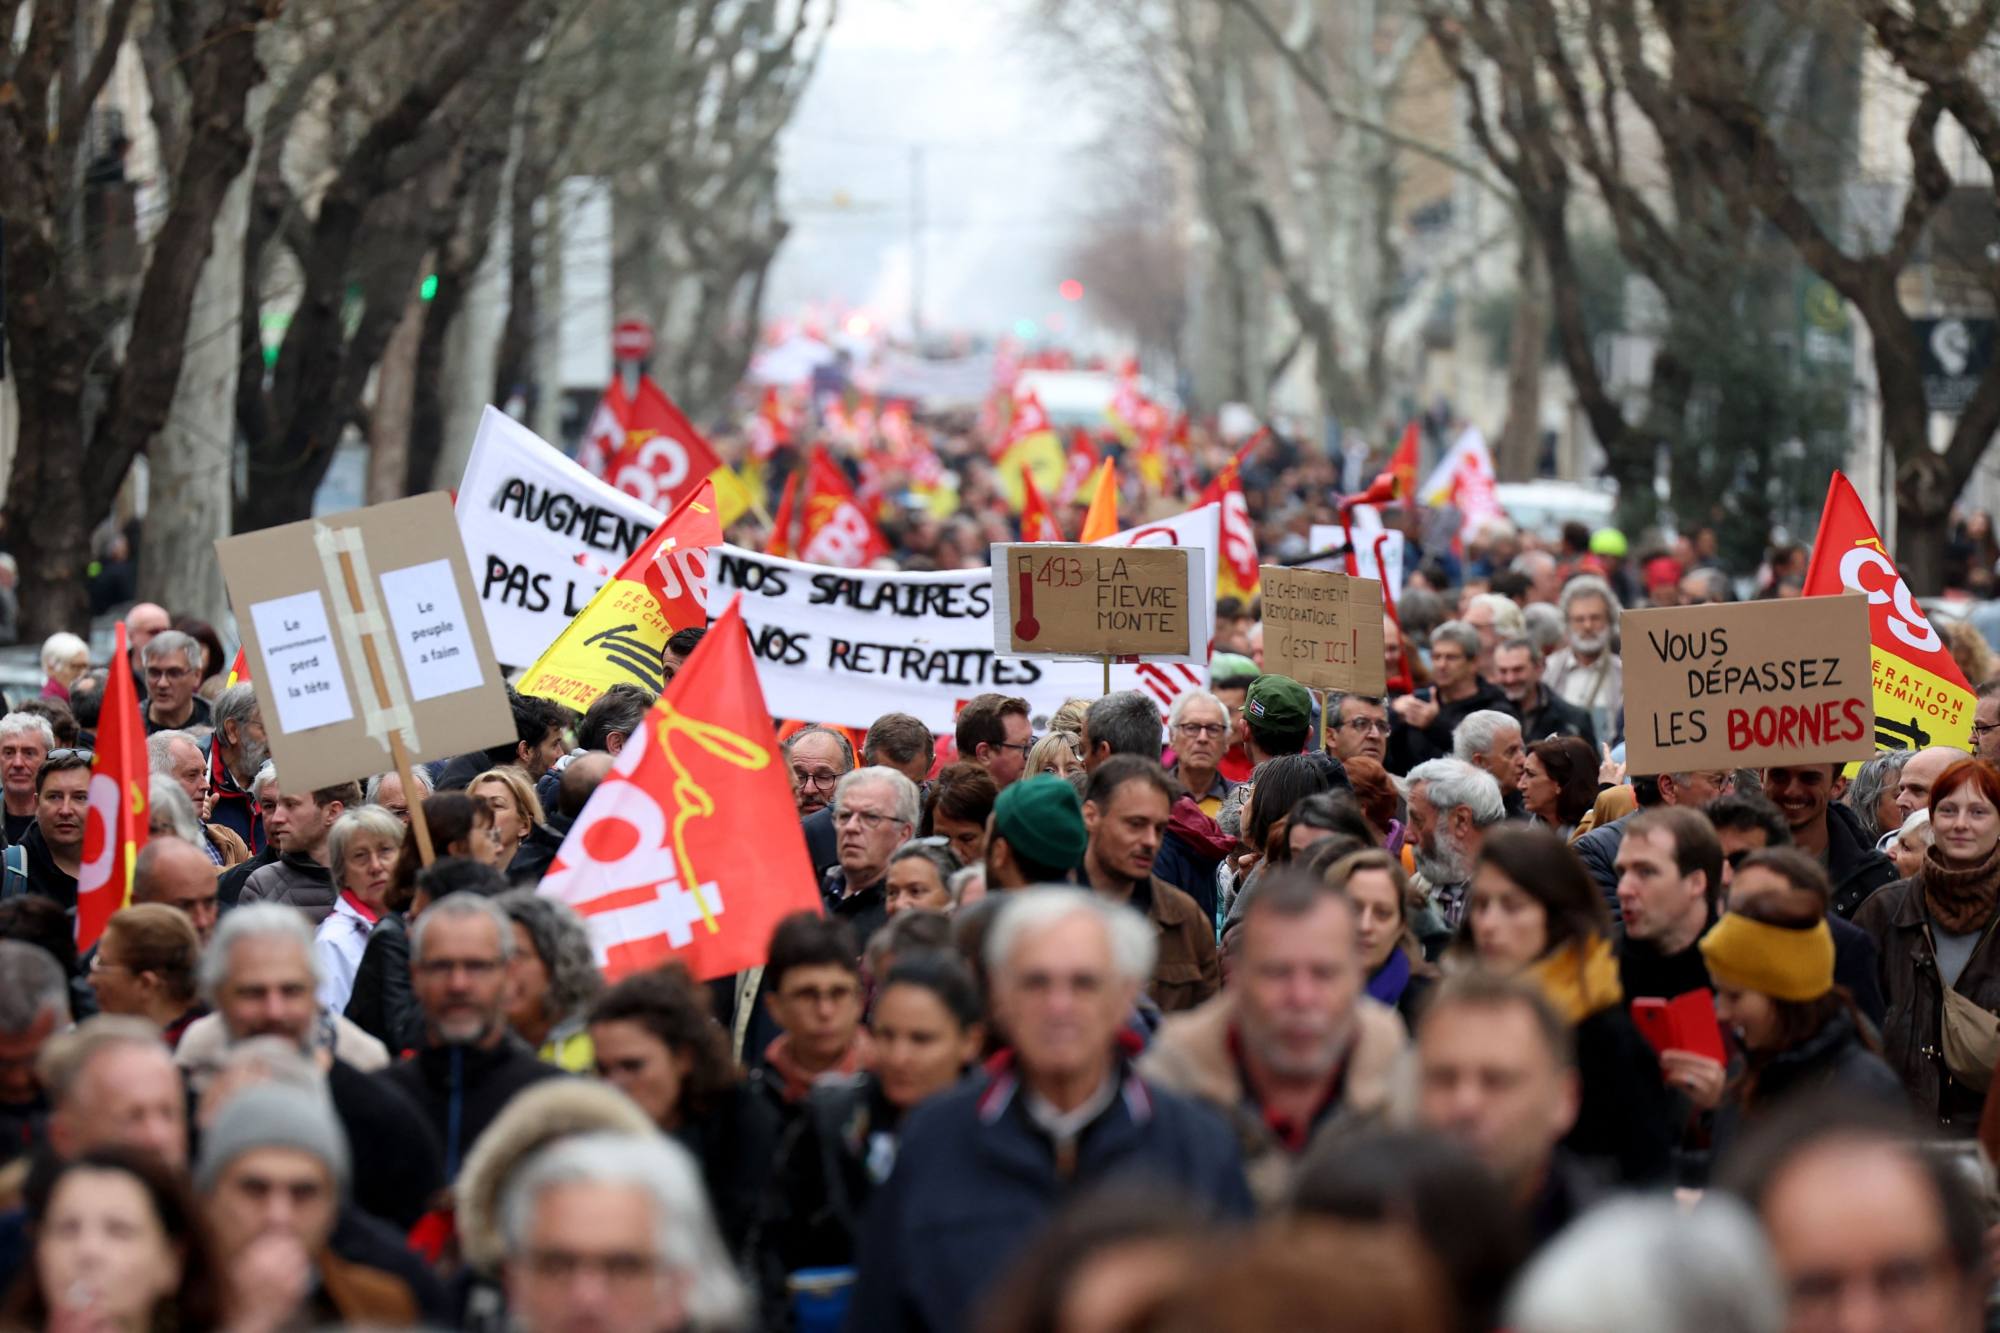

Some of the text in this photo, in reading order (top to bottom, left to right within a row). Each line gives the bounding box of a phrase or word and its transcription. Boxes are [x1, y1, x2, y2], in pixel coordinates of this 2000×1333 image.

[492, 479, 656, 558] AUGMEN
[482, 555, 552, 612] PAS
[1036, 556, 1129, 587] 49.3 LA
[717, 553, 993, 618] NOS SALAIRES
[1096, 584, 1177, 609] FIEVRE
[1277, 582, 1349, 602] CHEMINEMENT
[417, 602, 434, 614] Le
[283, 620, 300, 632] Le
[411, 621, 453, 642] peuple
[642, 613, 673, 637] CHE
[1097, 611, 1175, 633] MONTE
[420, 645, 460, 663] a faim
[746, 624, 1042, 685] NOS RETRAITES
[1280, 635, 1319, 660] C'EST
[1648, 628, 1729, 663] VOUS
[290, 655, 319, 675] perd
[1687, 658, 1843, 699] DÉPASSEZ
[1871, 659, 1965, 713] ÉRATION
[288, 685, 301, 698] la
[1872, 678, 1960, 726] HEMINOTS
[1653, 698, 1867, 752] LES BORNES
